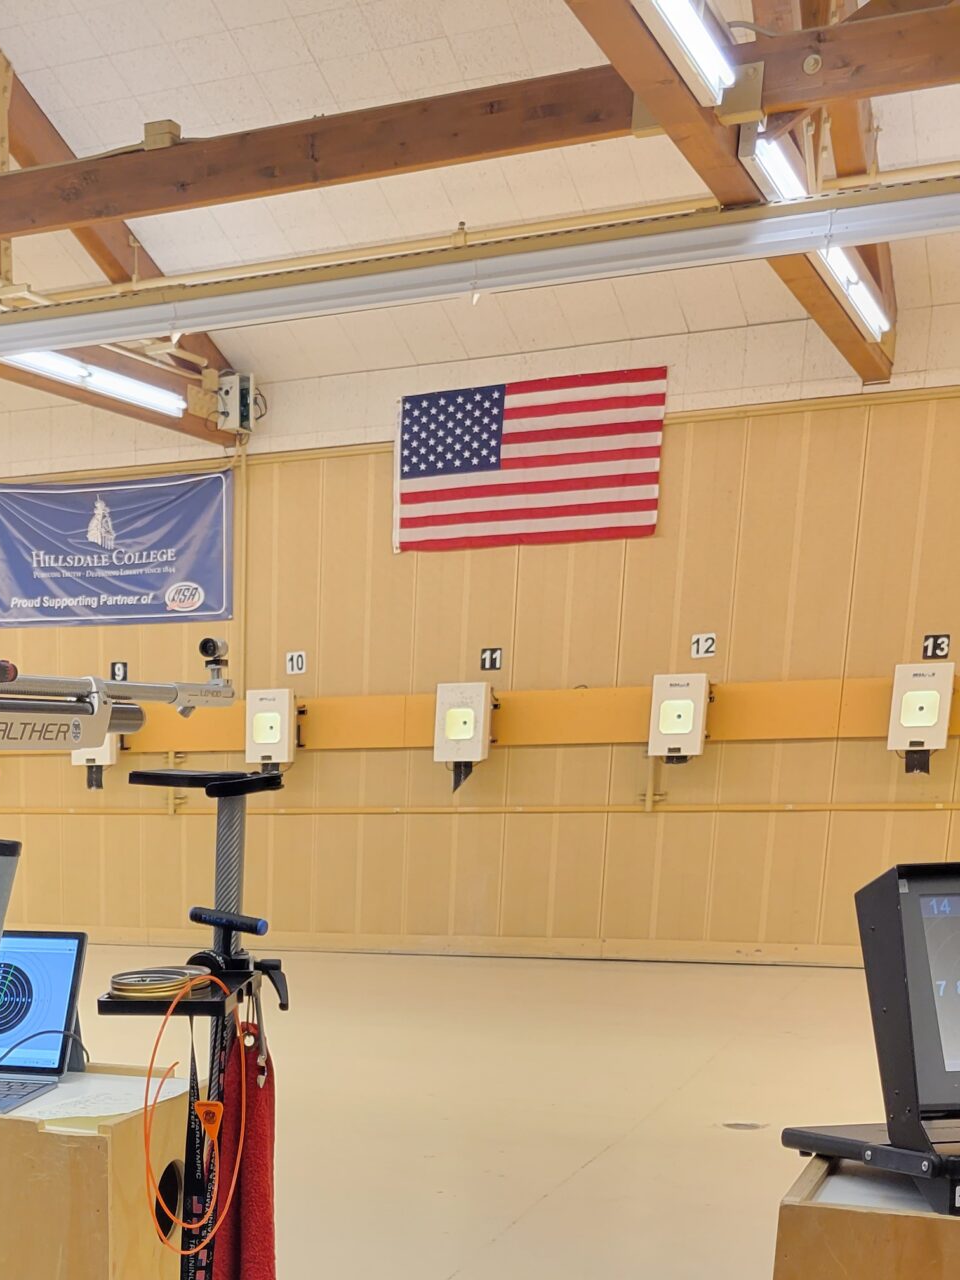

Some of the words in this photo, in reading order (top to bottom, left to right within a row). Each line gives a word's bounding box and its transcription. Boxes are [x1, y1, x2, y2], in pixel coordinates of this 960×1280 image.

[32, 551, 110, 568] HILLSDALE
[112, 548, 177, 566] COLLEGE
[10, 596, 42, 609] Proud
[43, 594, 98, 610] Supporting
[100, 594, 140, 607] Partner
[141, 593, 154, 605] of
[691, 638, 716, 655] 12
[923, 637, 949, 657] 13
[288, 654, 304, 671] 10
[482, 650, 502, 669] 11
[114, 664, 124, 680] 9
[930, 897, 951, 914] 14
[936, 980, 947, 996] 7
